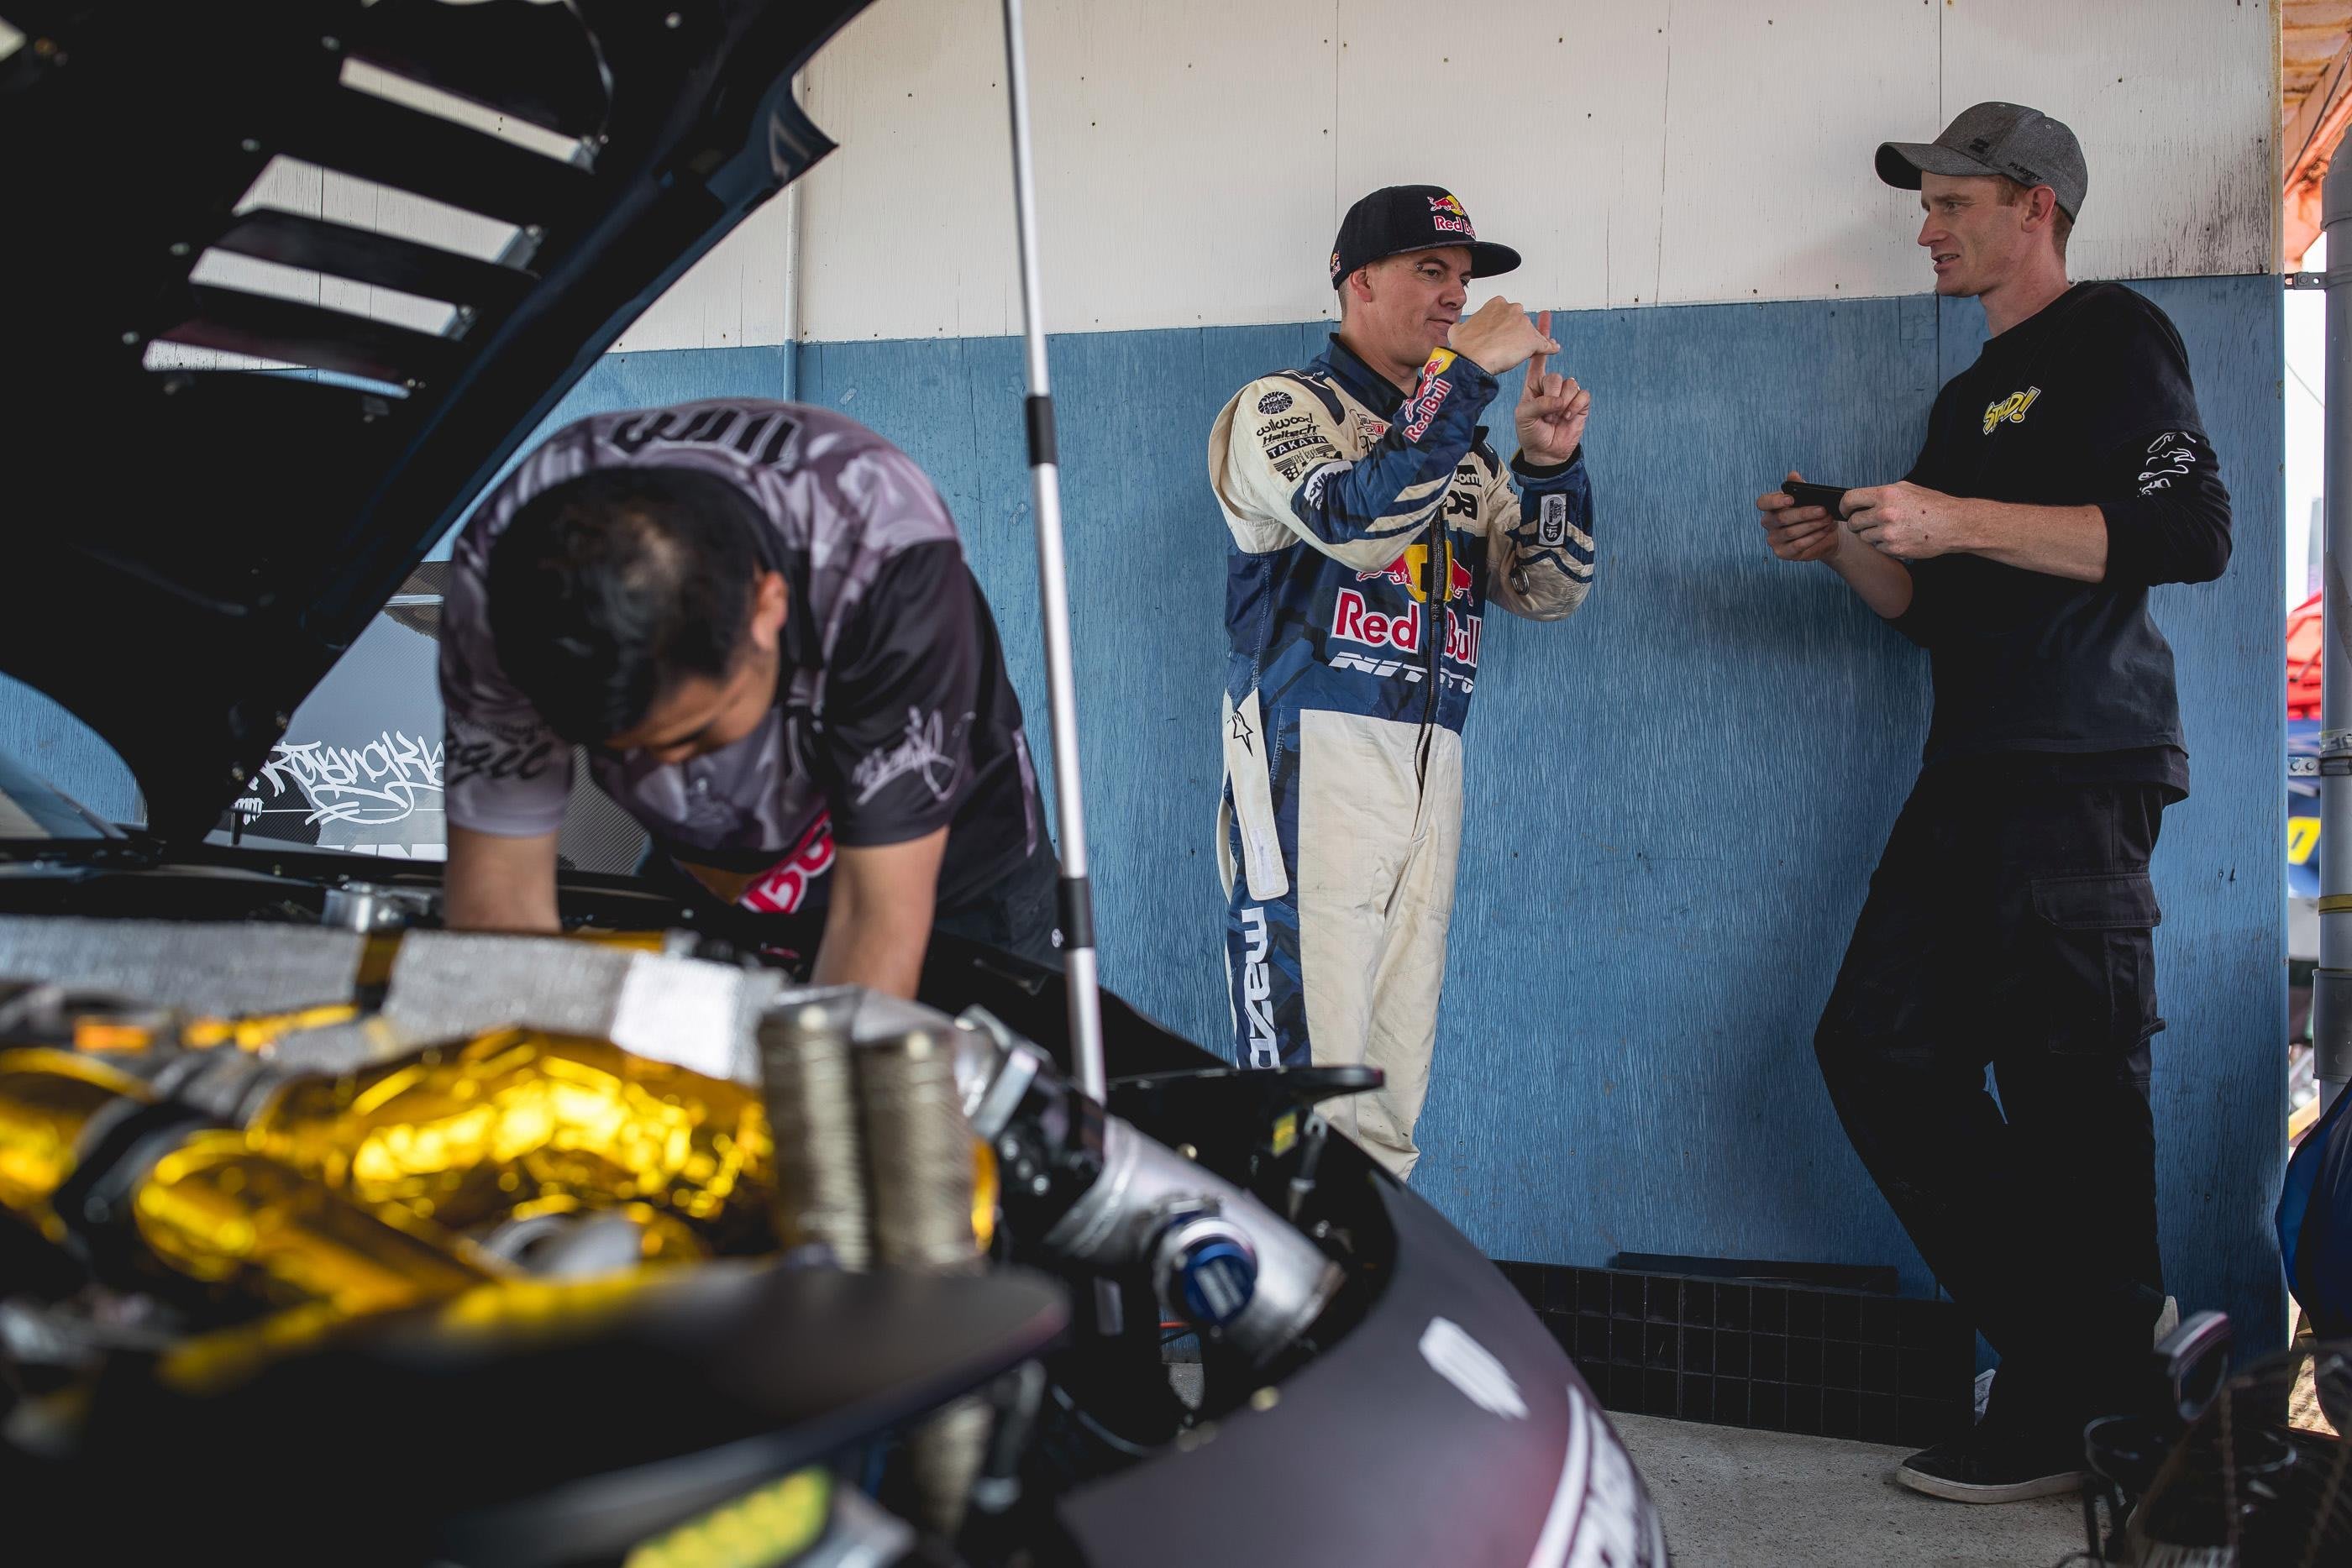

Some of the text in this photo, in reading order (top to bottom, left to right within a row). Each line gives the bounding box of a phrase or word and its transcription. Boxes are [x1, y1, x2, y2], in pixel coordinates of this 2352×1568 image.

[1433, 215, 1463, 232] Red
[1261, 394, 1287, 407] NGK
[1402, 378, 1452, 443] Red Bull
[1263, 424, 1317, 445] Haltech
[1268, 436, 1326, 458] TAKATA
[1331, 586, 1483, 669] Red Bull
